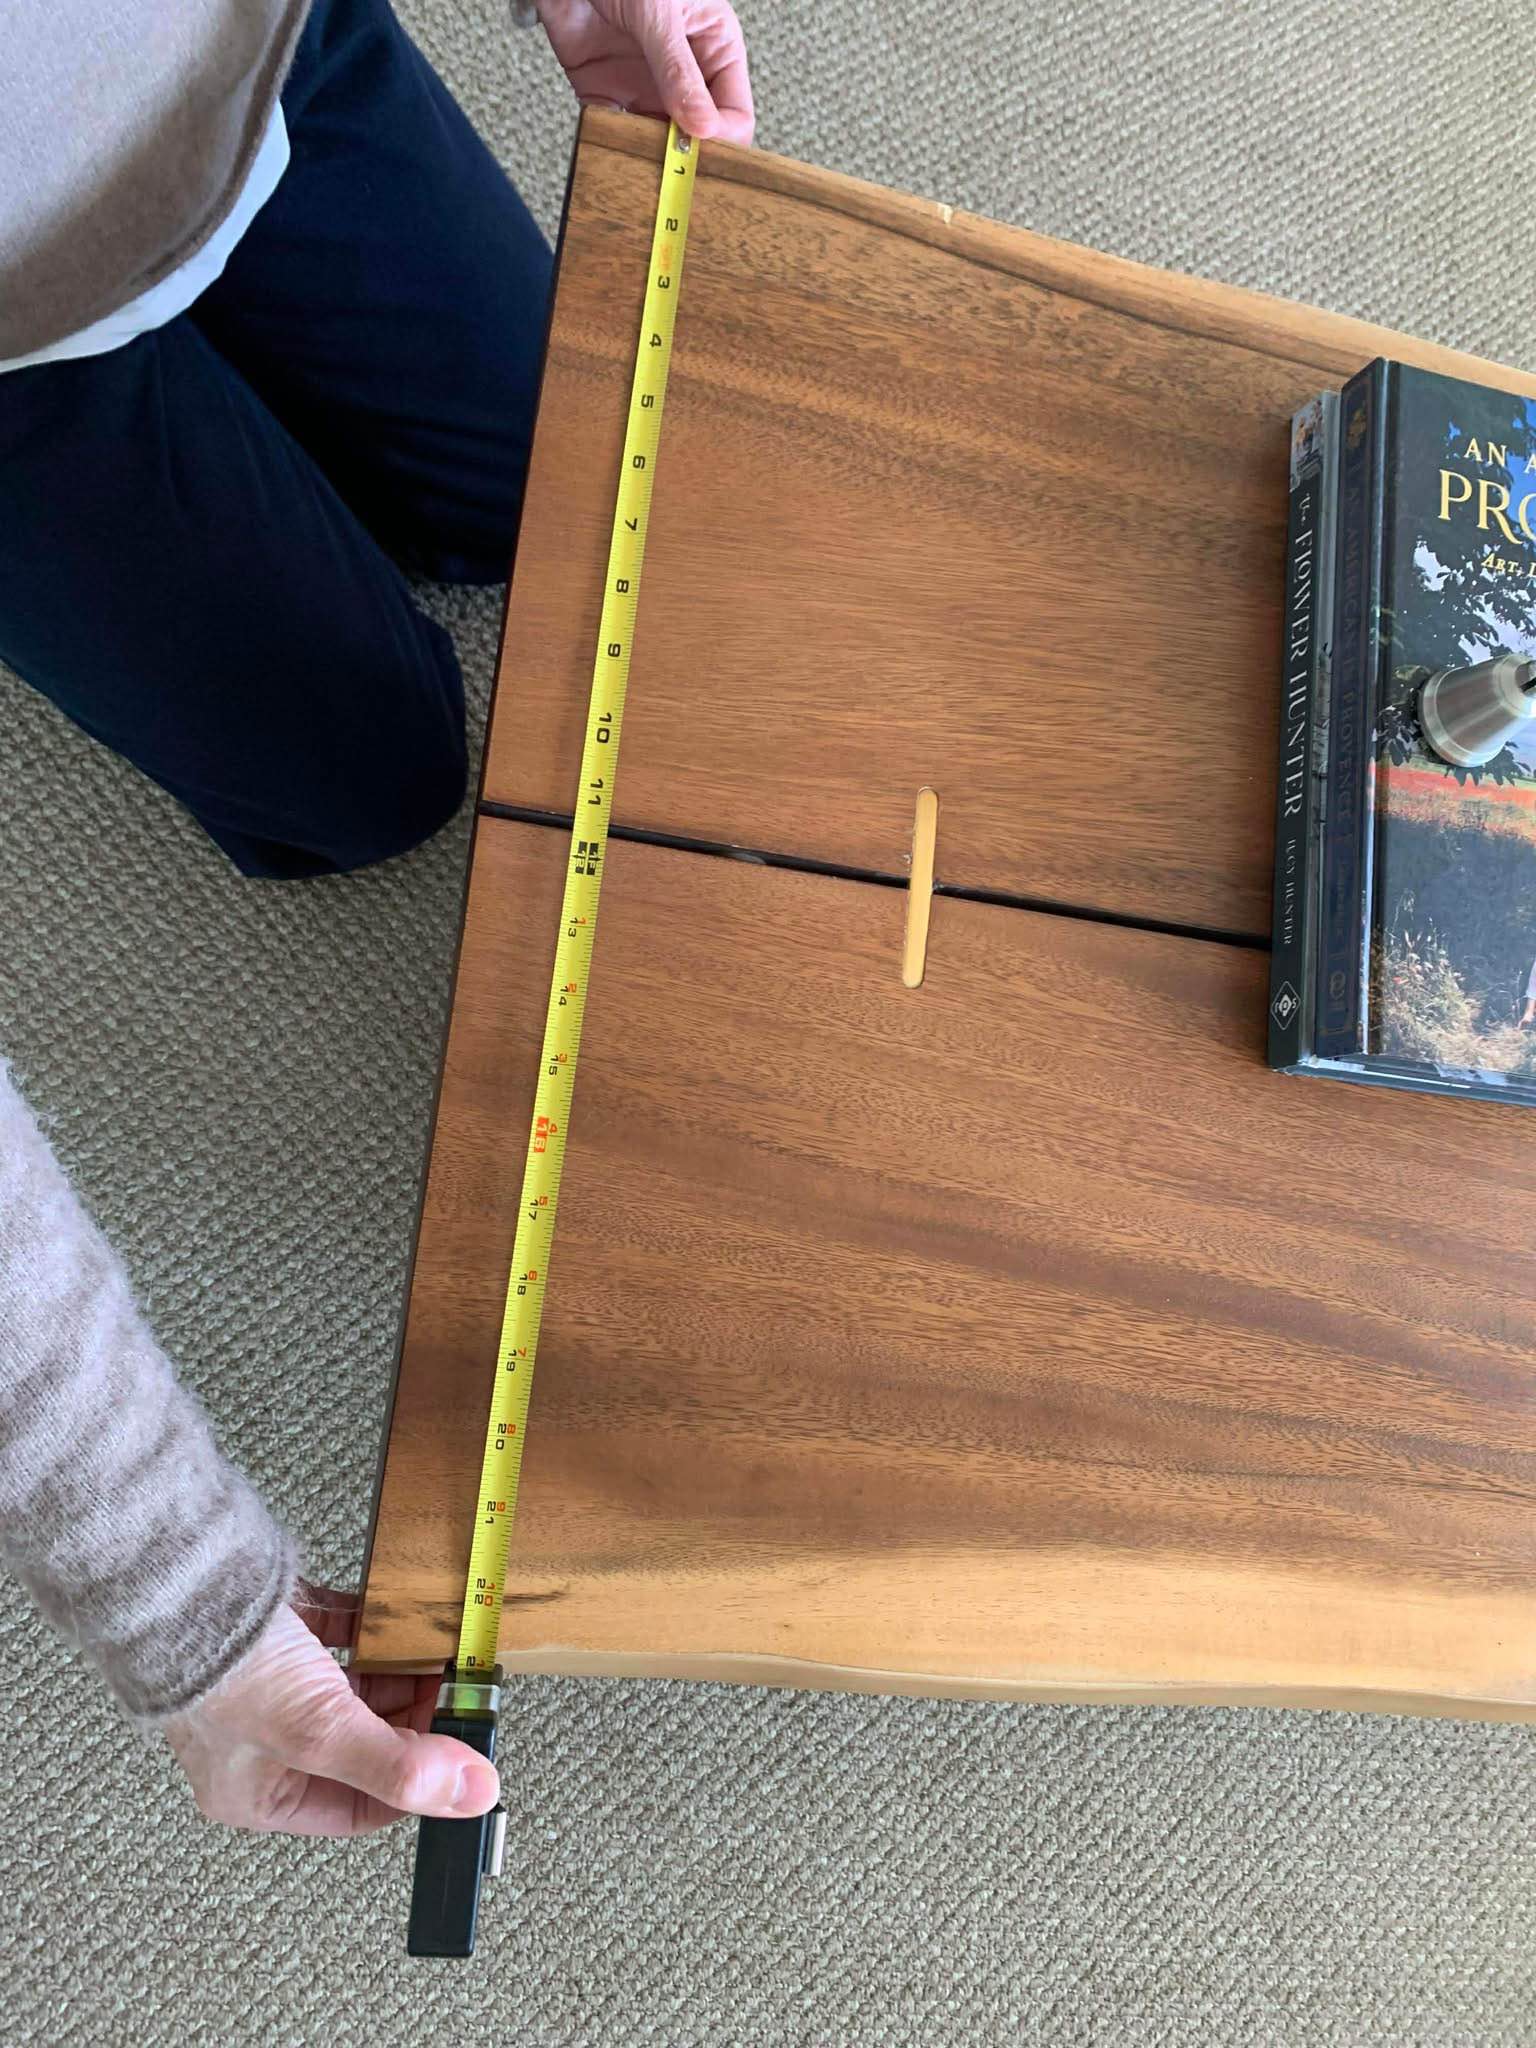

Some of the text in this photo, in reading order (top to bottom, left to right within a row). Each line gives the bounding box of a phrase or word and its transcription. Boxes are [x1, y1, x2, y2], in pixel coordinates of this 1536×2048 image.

[673, 166, 685, 176] 1
[665, 218, 679, 231] 2
[657, 275, 670, 289] 3
[649, 333, 662, 348] 4
[641, 394, 654, 408] 5
[632, 455, 646, 469] 6
[1463, 437, 1507, 468] AN
[625, 518, 638, 531] 7
[616, 578, 629, 593] 8
[1290, 529, 1313, 662] FLOWER
[607, 643, 621, 657] 9
[596, 712, 612, 743] 10
[1284, 670, 1308, 818] HUNTER
[588, 778, 604, 806] 11
[1283, 881, 1296, 945] HUNTER
[567, 917, 579, 938] 13
[558, 985, 570, 1006] 14
[548, 1054, 559, 1076] 15
[528, 1199, 539, 1221] 17
[517, 1273, 528, 1296] 18
[506, 1350, 517, 1372] 19
[495, 1423, 507, 1450] 20
[485, 1500, 497, 1525] 21
[474, 1578, 486, 1605] 22
